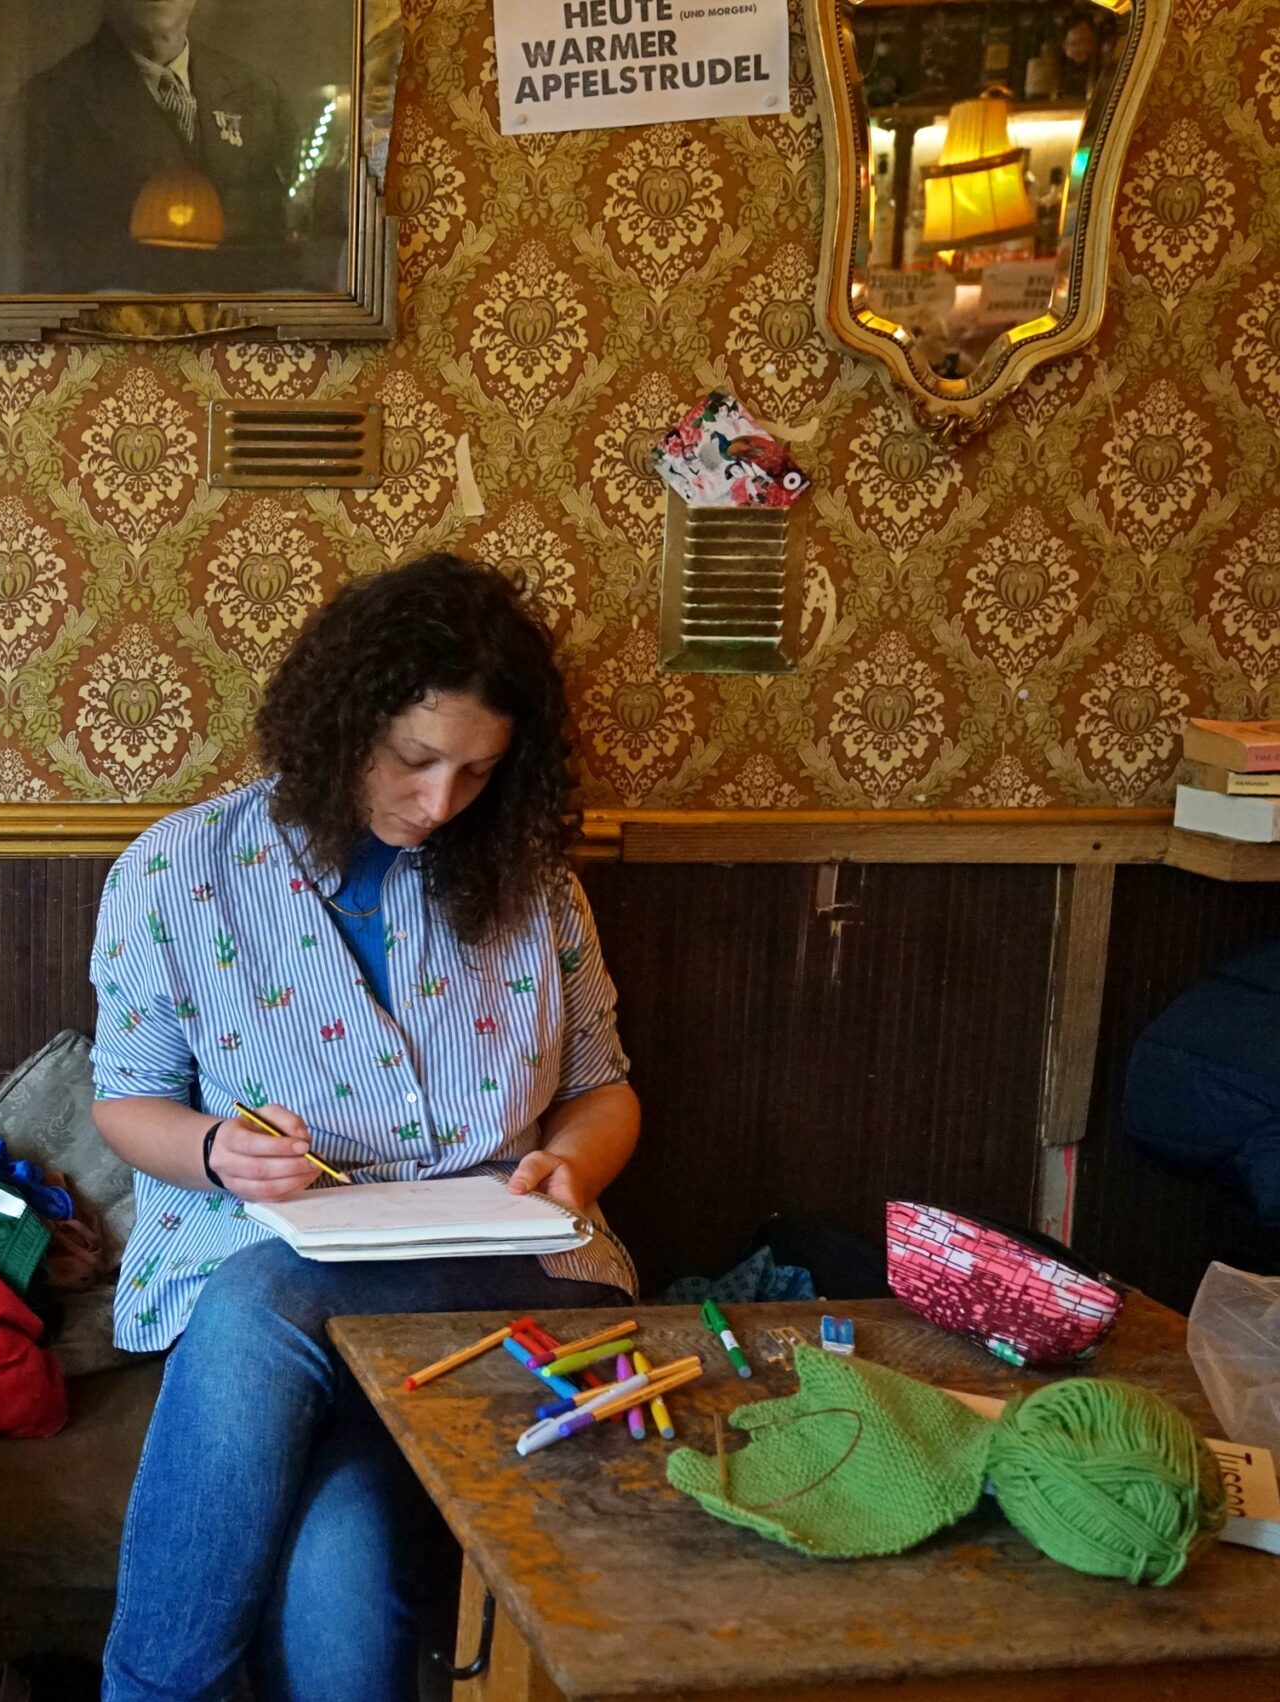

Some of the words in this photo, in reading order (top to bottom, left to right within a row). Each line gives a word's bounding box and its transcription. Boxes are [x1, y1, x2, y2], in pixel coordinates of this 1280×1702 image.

[563, 0, 673, 29] HEUTE
[679, 10, 705, 21] (UND
[708, 4, 757, 17] MORGEN)
[521, 29, 678, 69] WARMER
[514, 53, 770, 105] APFELSTRUDEL
